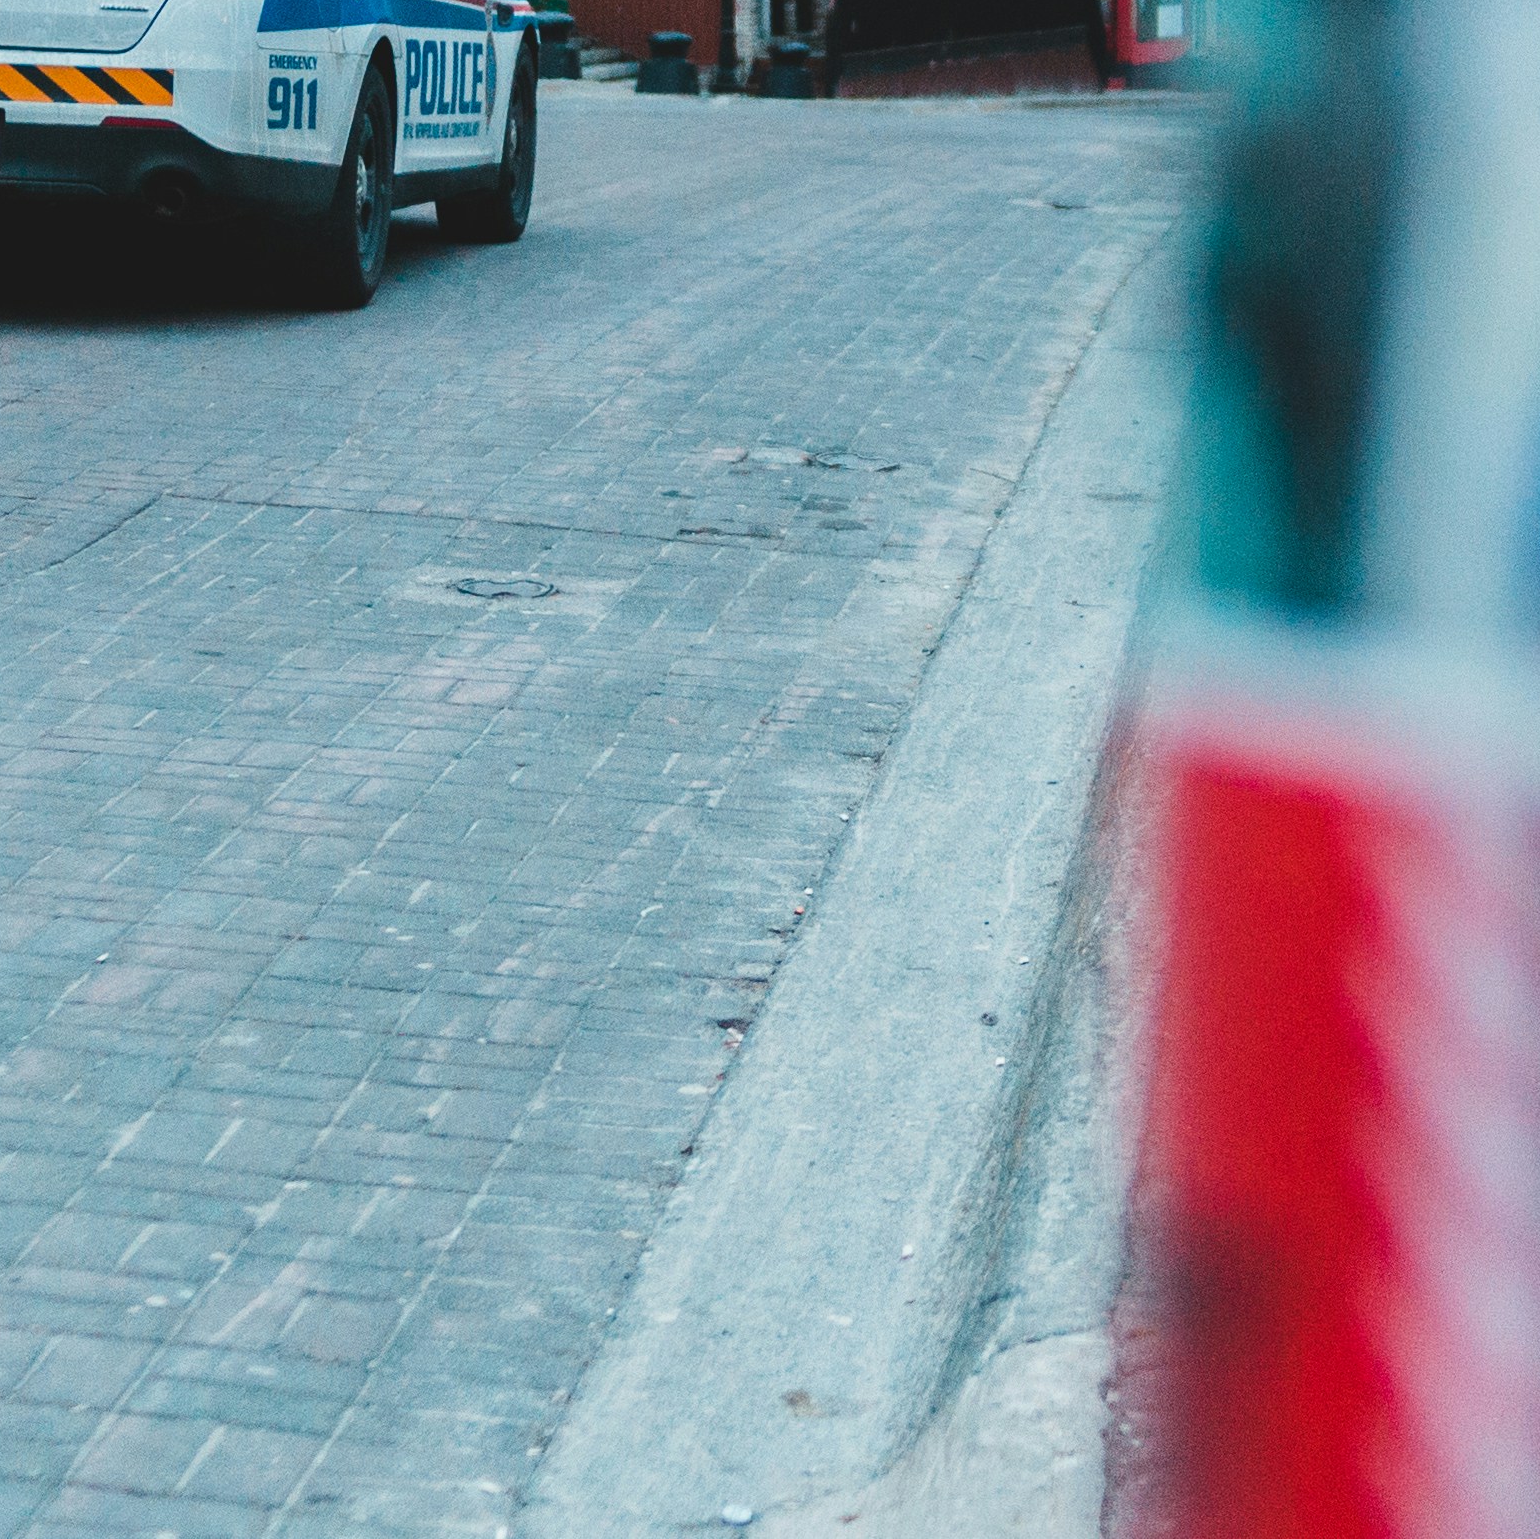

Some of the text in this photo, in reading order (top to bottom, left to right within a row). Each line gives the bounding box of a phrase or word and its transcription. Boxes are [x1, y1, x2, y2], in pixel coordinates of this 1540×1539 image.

[269, 54, 318, 70] EMERGENCY
[404, 38, 484, 116] POLICE
[267, 77, 318, 129] 911
